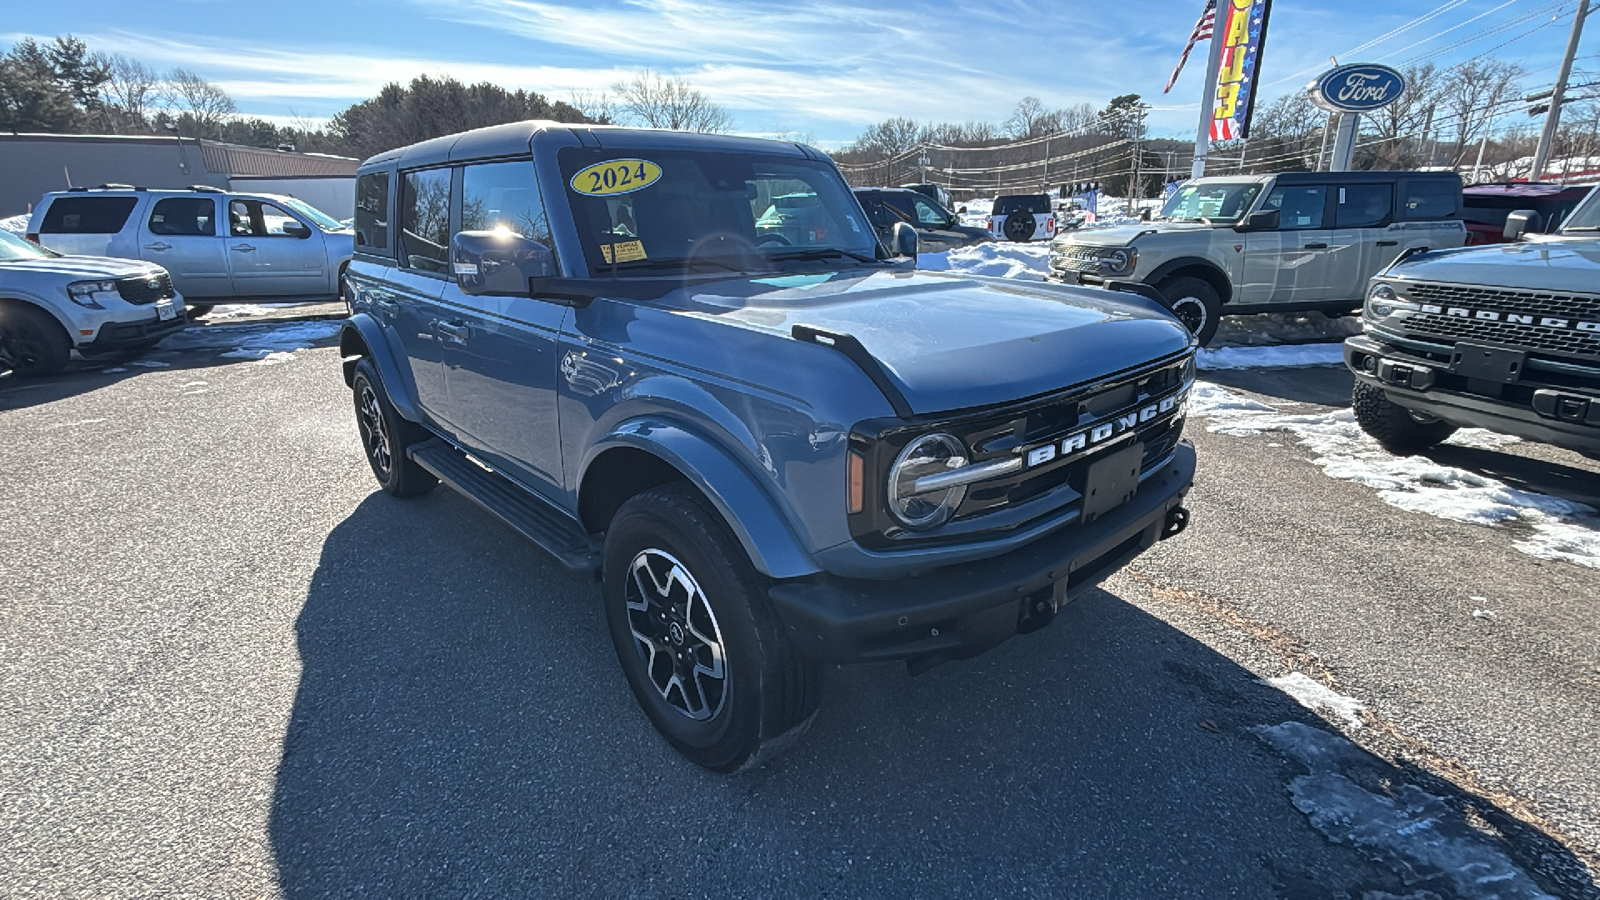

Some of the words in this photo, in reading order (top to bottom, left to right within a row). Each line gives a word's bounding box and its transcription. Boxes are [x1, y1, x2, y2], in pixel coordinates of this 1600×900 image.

[1338, 73, 1392, 101] Ford
[588, 162, 646, 192] 2024
[1421, 304, 1600, 332] BRONCO
[1027, 396, 1177, 467] BRONCO
